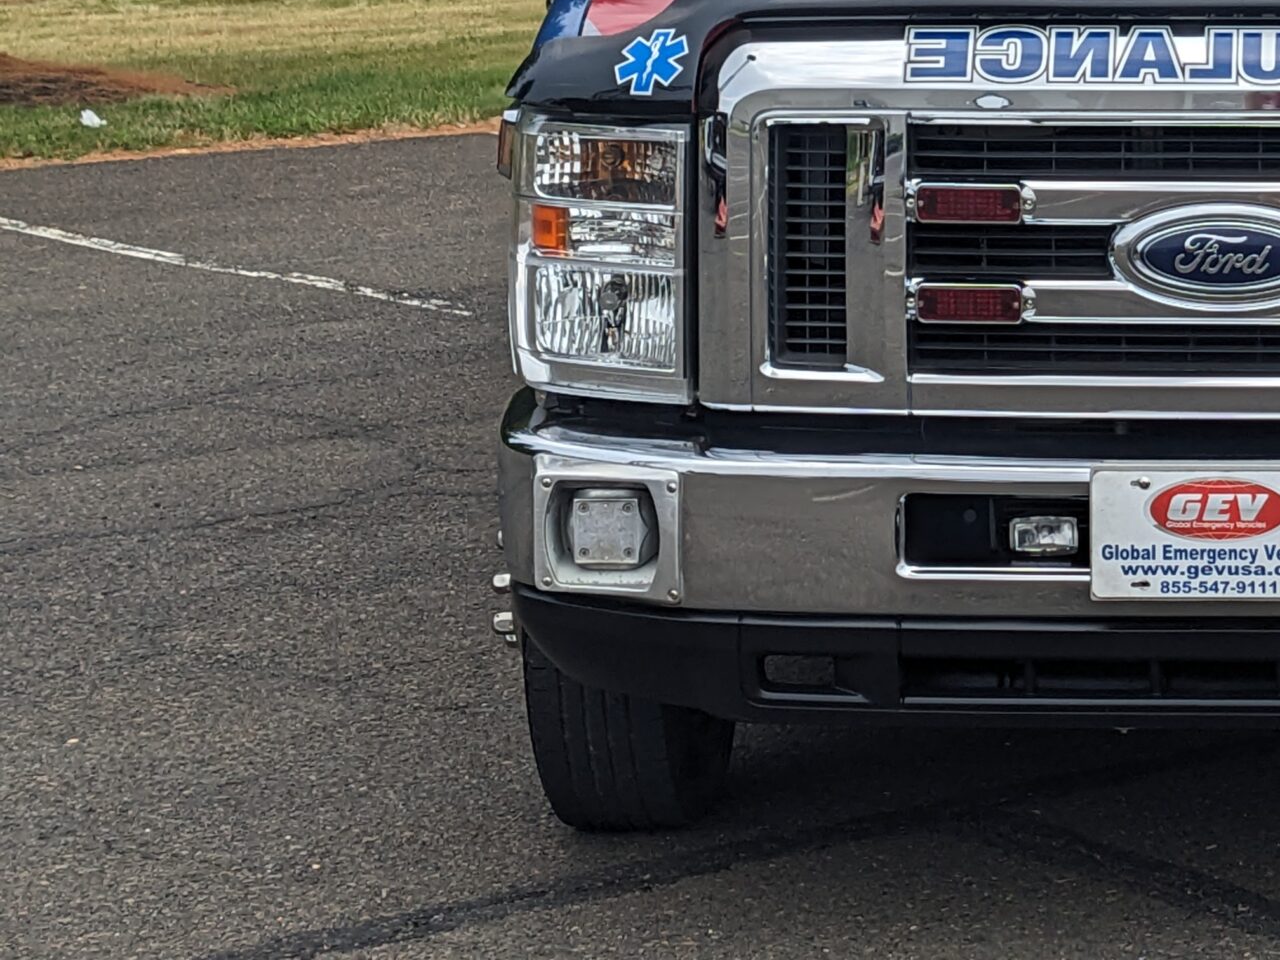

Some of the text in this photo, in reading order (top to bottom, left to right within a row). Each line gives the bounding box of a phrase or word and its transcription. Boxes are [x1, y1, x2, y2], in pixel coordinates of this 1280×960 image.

[1174, 233, 1272, 274] Ford
[1166, 493, 1269, 521] GEV
[1165, 520, 1191, 529] Global
[1101, 544, 1156, 561] Global
[1162, 544, 1258, 564] Emergency
[1160, 580, 1278, 594] 855-547-9111
